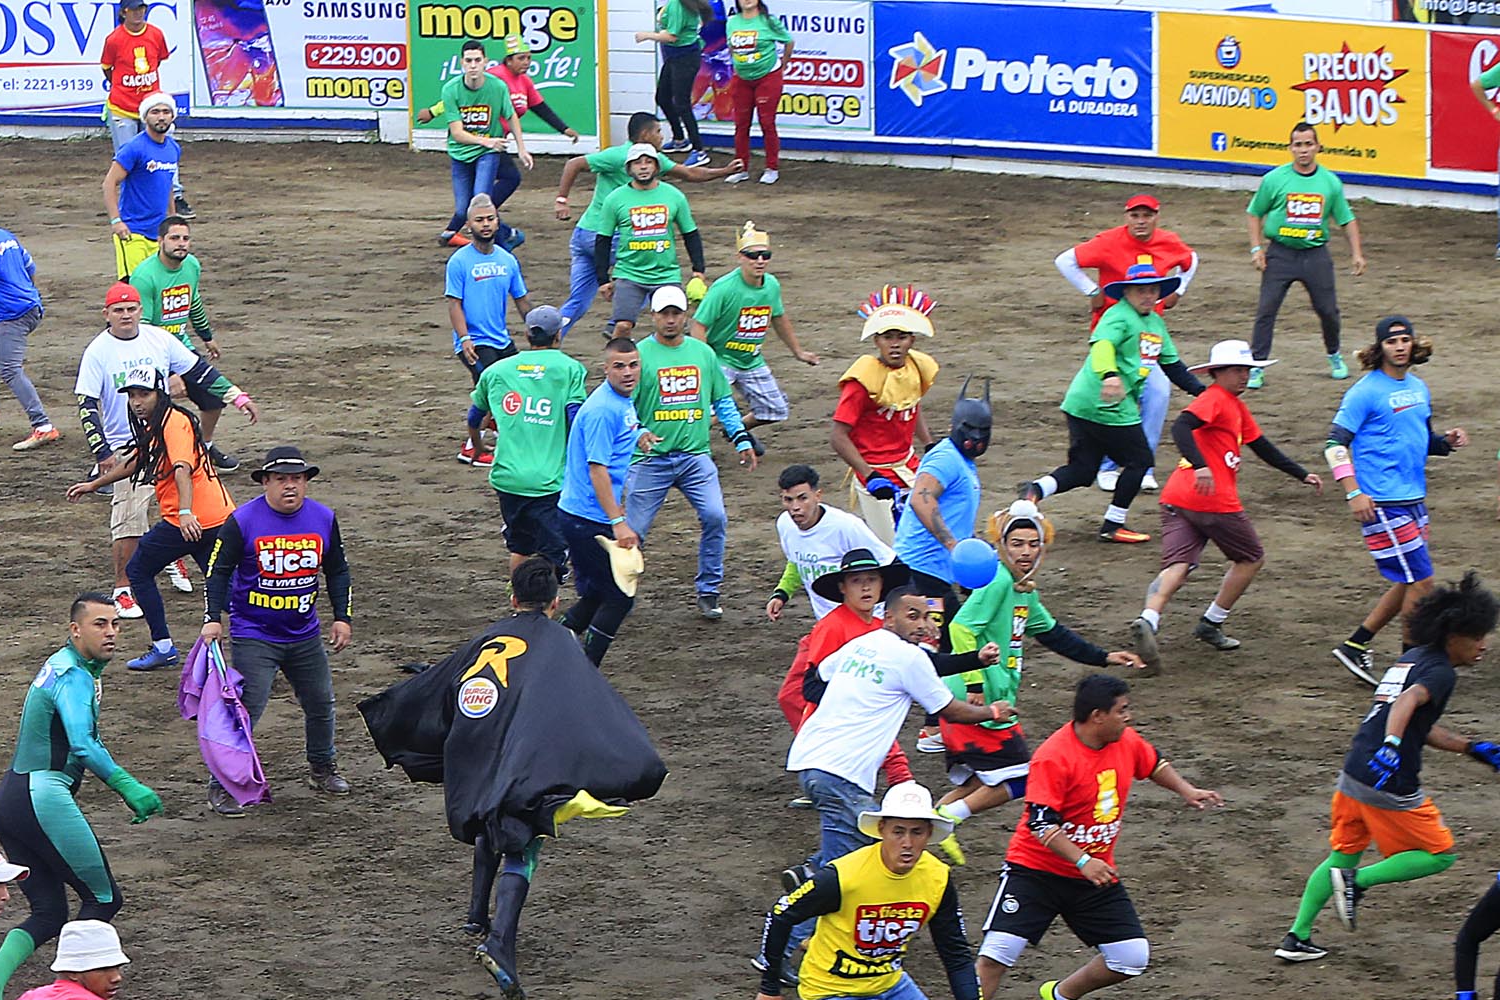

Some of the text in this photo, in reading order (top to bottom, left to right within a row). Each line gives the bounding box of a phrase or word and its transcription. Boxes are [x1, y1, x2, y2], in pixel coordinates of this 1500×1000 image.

[303, 2, 406, 19] SAMSUNG
[419, 5, 578, 52] monge
[779, 15, 865, 33] AMSUNG
[545, 46, 581, 78] fe!
[1303, 53, 1394, 82] PRECIOS
[951, 48, 1139, 100] Protecto
[1189, 70, 1270, 84] SUPERMERCADO
[23, 78, 93, 91] 2221-9139
[307, 77, 405, 106] monge
[1180, 83, 1277, 110] AVENIDA 10
[1049, 100, 1138, 117] LA DURADERA
[1305, 89, 1398, 125] BAJOS
[1231, 137, 1292, 151] /Supermer
[1365, 148, 1377, 159] 10
[1287, 200, 1321, 215] tica
[631, 213, 666, 228] tica
[628, 240, 671, 253] monge
[162, 294, 189, 311] tica
[739, 315, 768, 330] tica
[725, 341, 763, 356] mong
[660, 376, 697, 394] tica
[525, 397, 552, 416] LG
[654, 408, 703, 423] monge
[259, 538, 317, 550] La fiesta
[259, 549, 319, 575] tica
[261, 577, 316, 587] SE VIVE CON
[463, 695, 493, 705] KING
[861, 906, 923, 919] La fiesta
